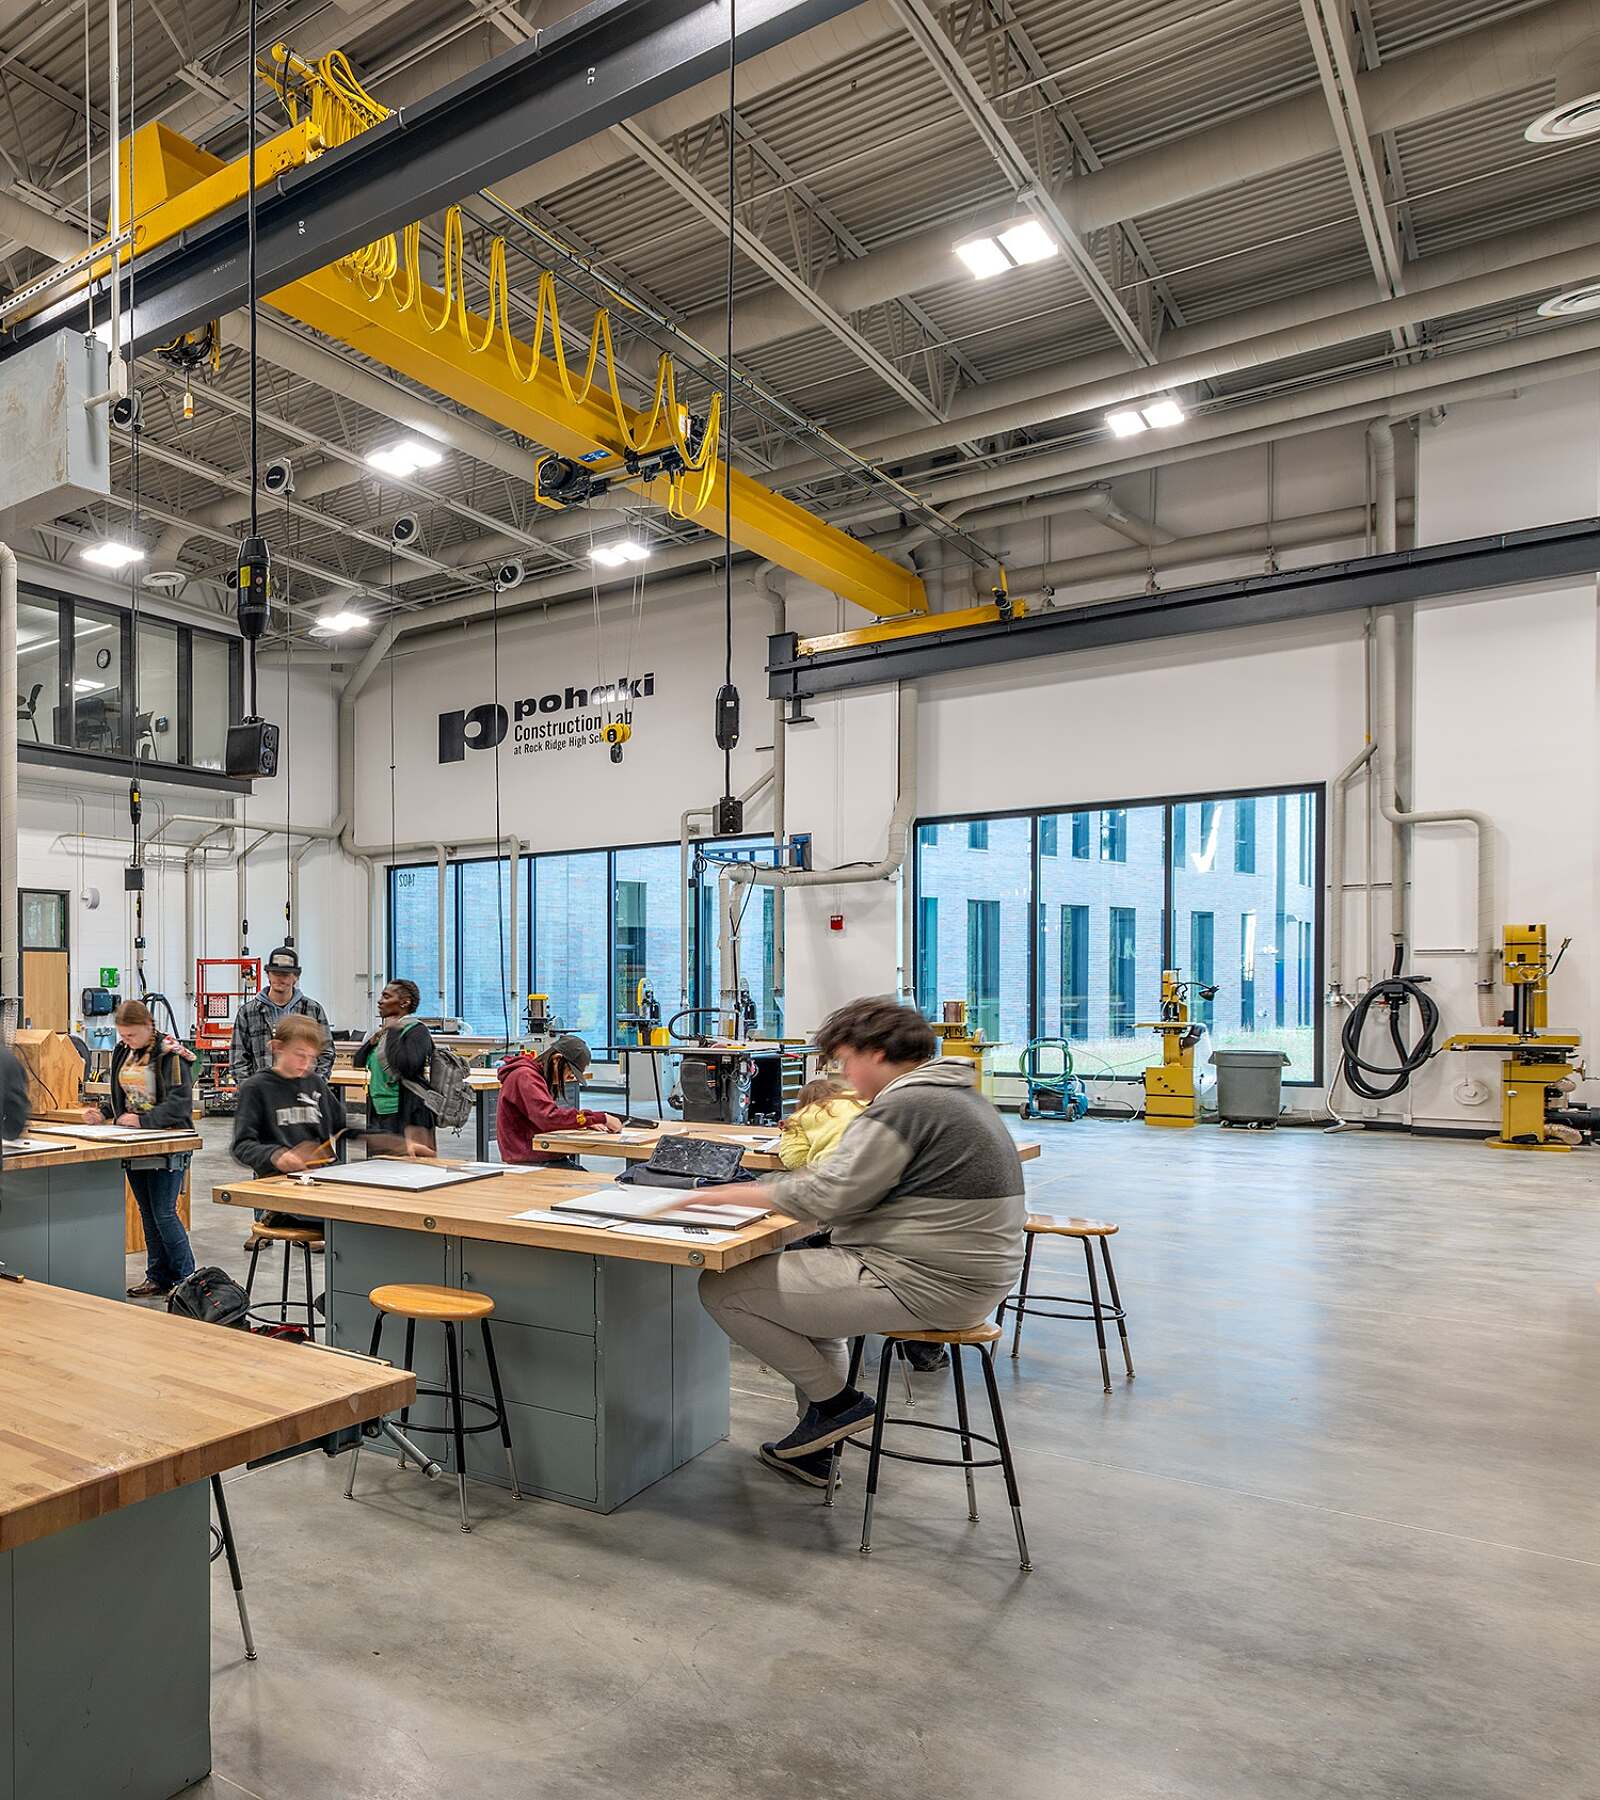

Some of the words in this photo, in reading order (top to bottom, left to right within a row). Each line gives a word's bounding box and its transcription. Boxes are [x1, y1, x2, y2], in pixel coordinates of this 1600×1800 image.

[514, 672, 655, 722] pohaki
[514, 714, 602, 742] Construction
[513, 745, 522, 755] at
[524, 741, 543, 754] Rock
[544, 738, 567, 751] Ridge
[569, 733, 587, 748] High
